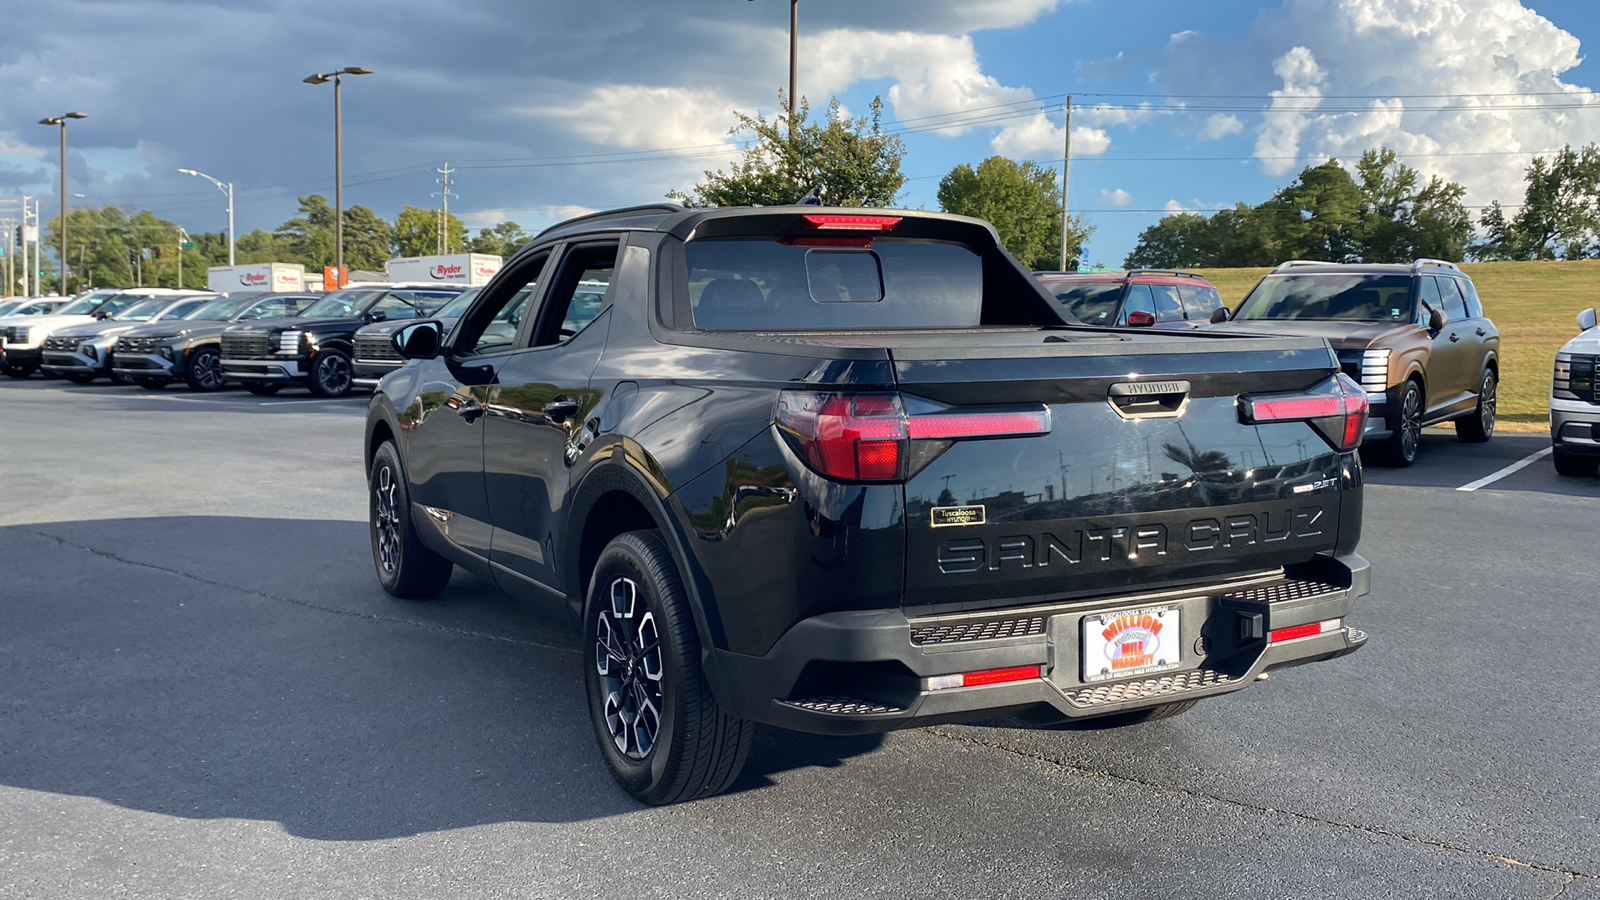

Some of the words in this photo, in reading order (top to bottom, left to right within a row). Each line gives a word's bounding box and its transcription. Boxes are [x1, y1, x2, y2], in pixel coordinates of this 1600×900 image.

[437, 264, 462, 276] Ryder
[480, 267, 495, 275] Ryder
[246, 273, 266, 283] Ryder
[1128, 382, 1180, 394] HYUNDAI
[941, 509, 977, 517] Tuscaloosa
[937, 523, 1168, 574] SANTA
[1184, 505, 1323, 551] CRUZ
[1100, 609, 1140, 620] TUSCALOOSA
[1101, 614, 1163, 642] MILLION
[1121, 641, 1144, 656] MILE
[1111, 653, 1155, 670] WARRANTY
[1090, 674, 1105, 682] HOME
[1113, 670, 1134, 678] MILLION
